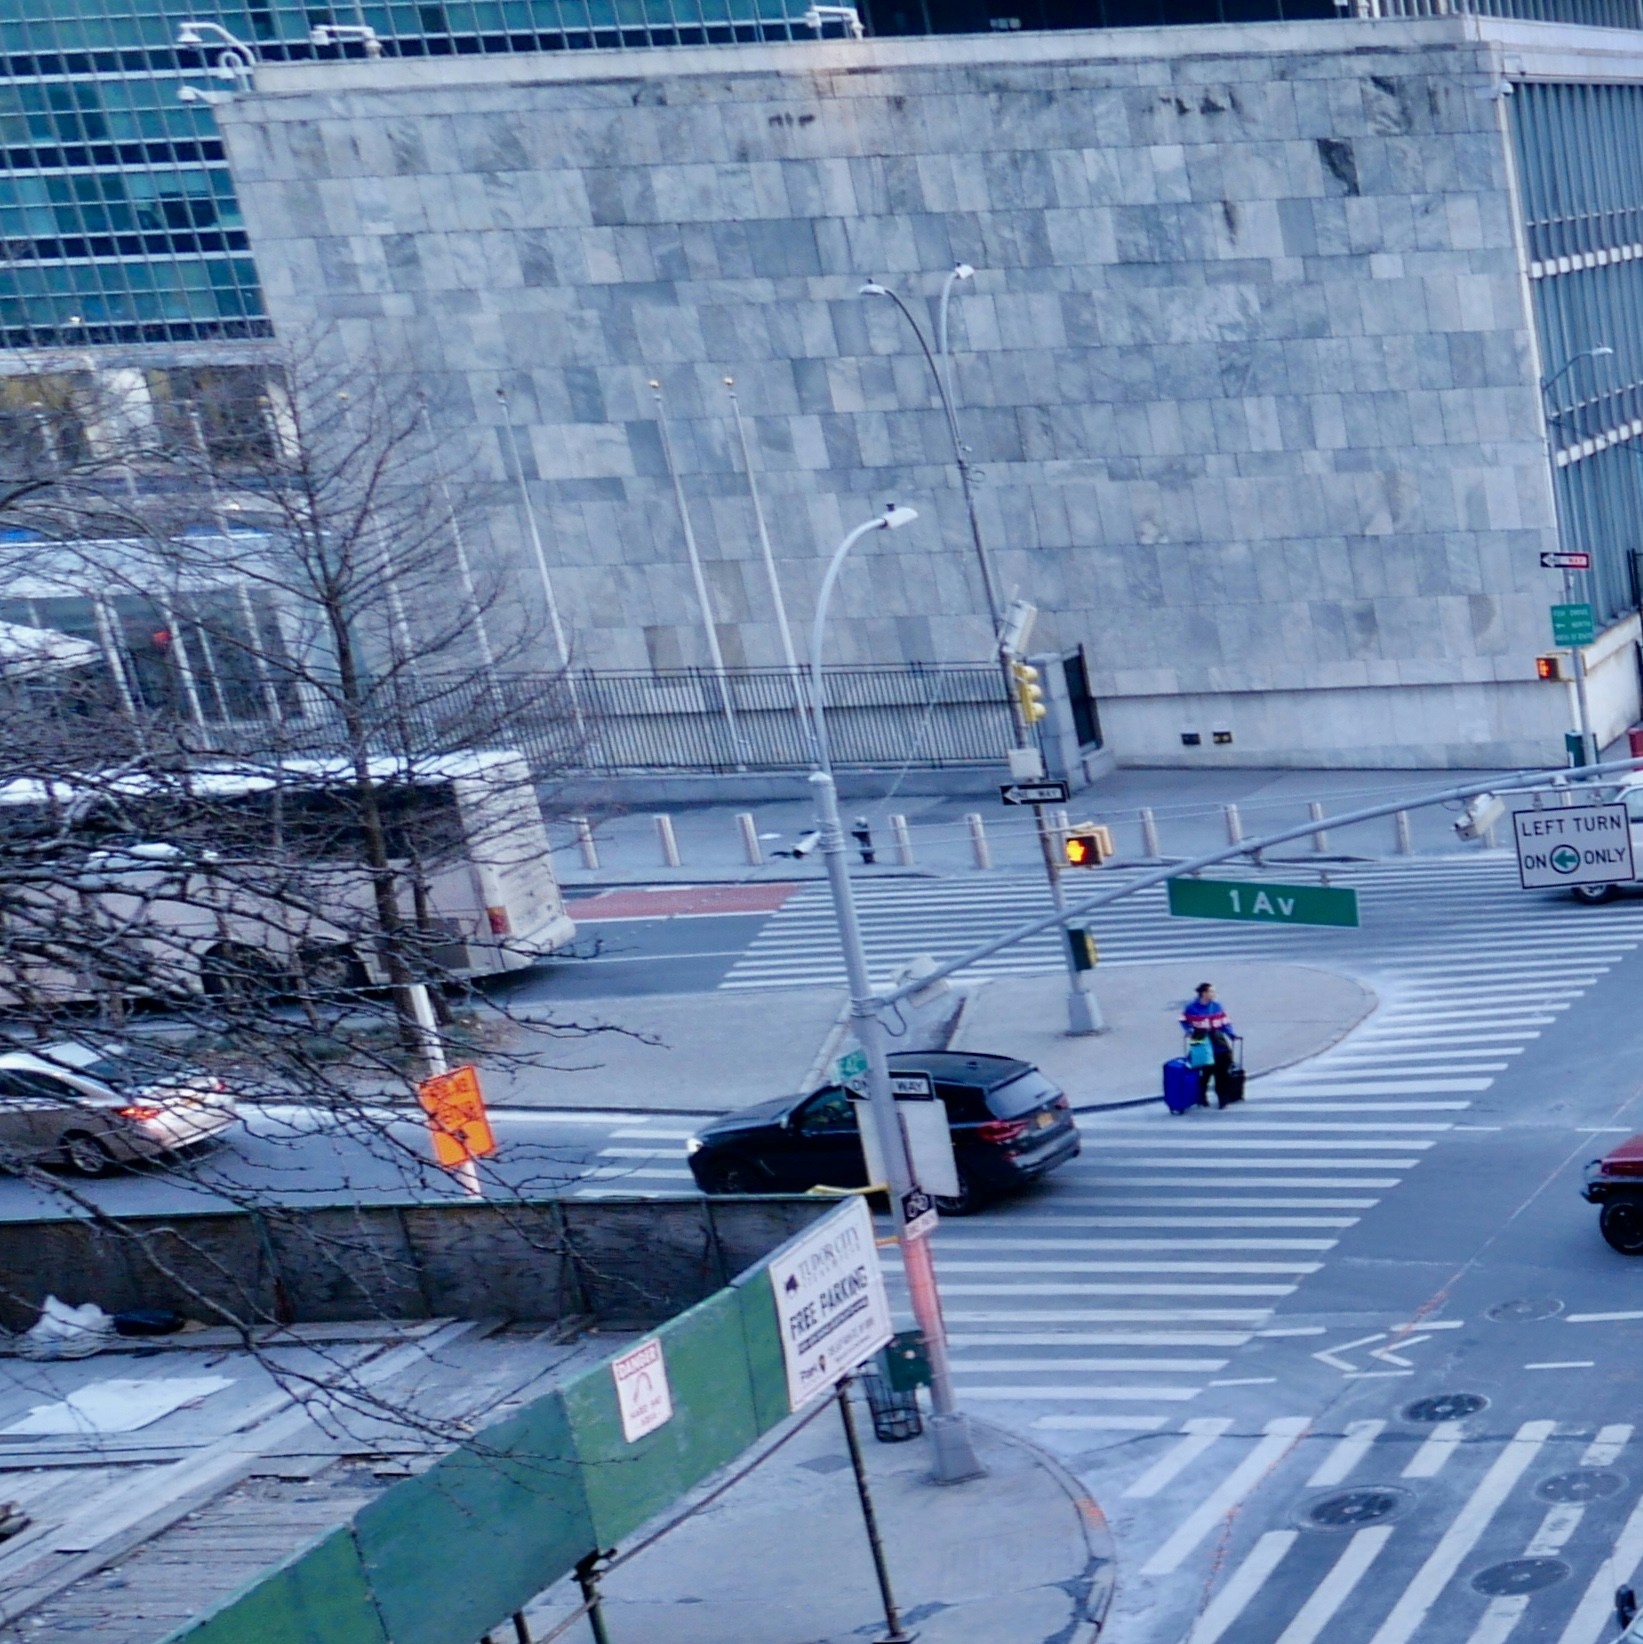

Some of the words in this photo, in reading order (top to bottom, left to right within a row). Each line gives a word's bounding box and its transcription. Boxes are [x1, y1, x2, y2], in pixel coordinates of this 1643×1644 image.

[1522, 818, 1565, 837] LEFT
[1573, 815, 1622, 832] TURN
[1524, 854, 1547, 870] ON
[1584, 847, 1625, 865] ONLY
[1229, 888, 1241, 914] 1
[1252, 890, 1296, 917] Av
[897, 1080, 924, 1092] WAY
[789, 1301, 817, 1342] FREE
[819, 1264, 868, 1319] PARKING
